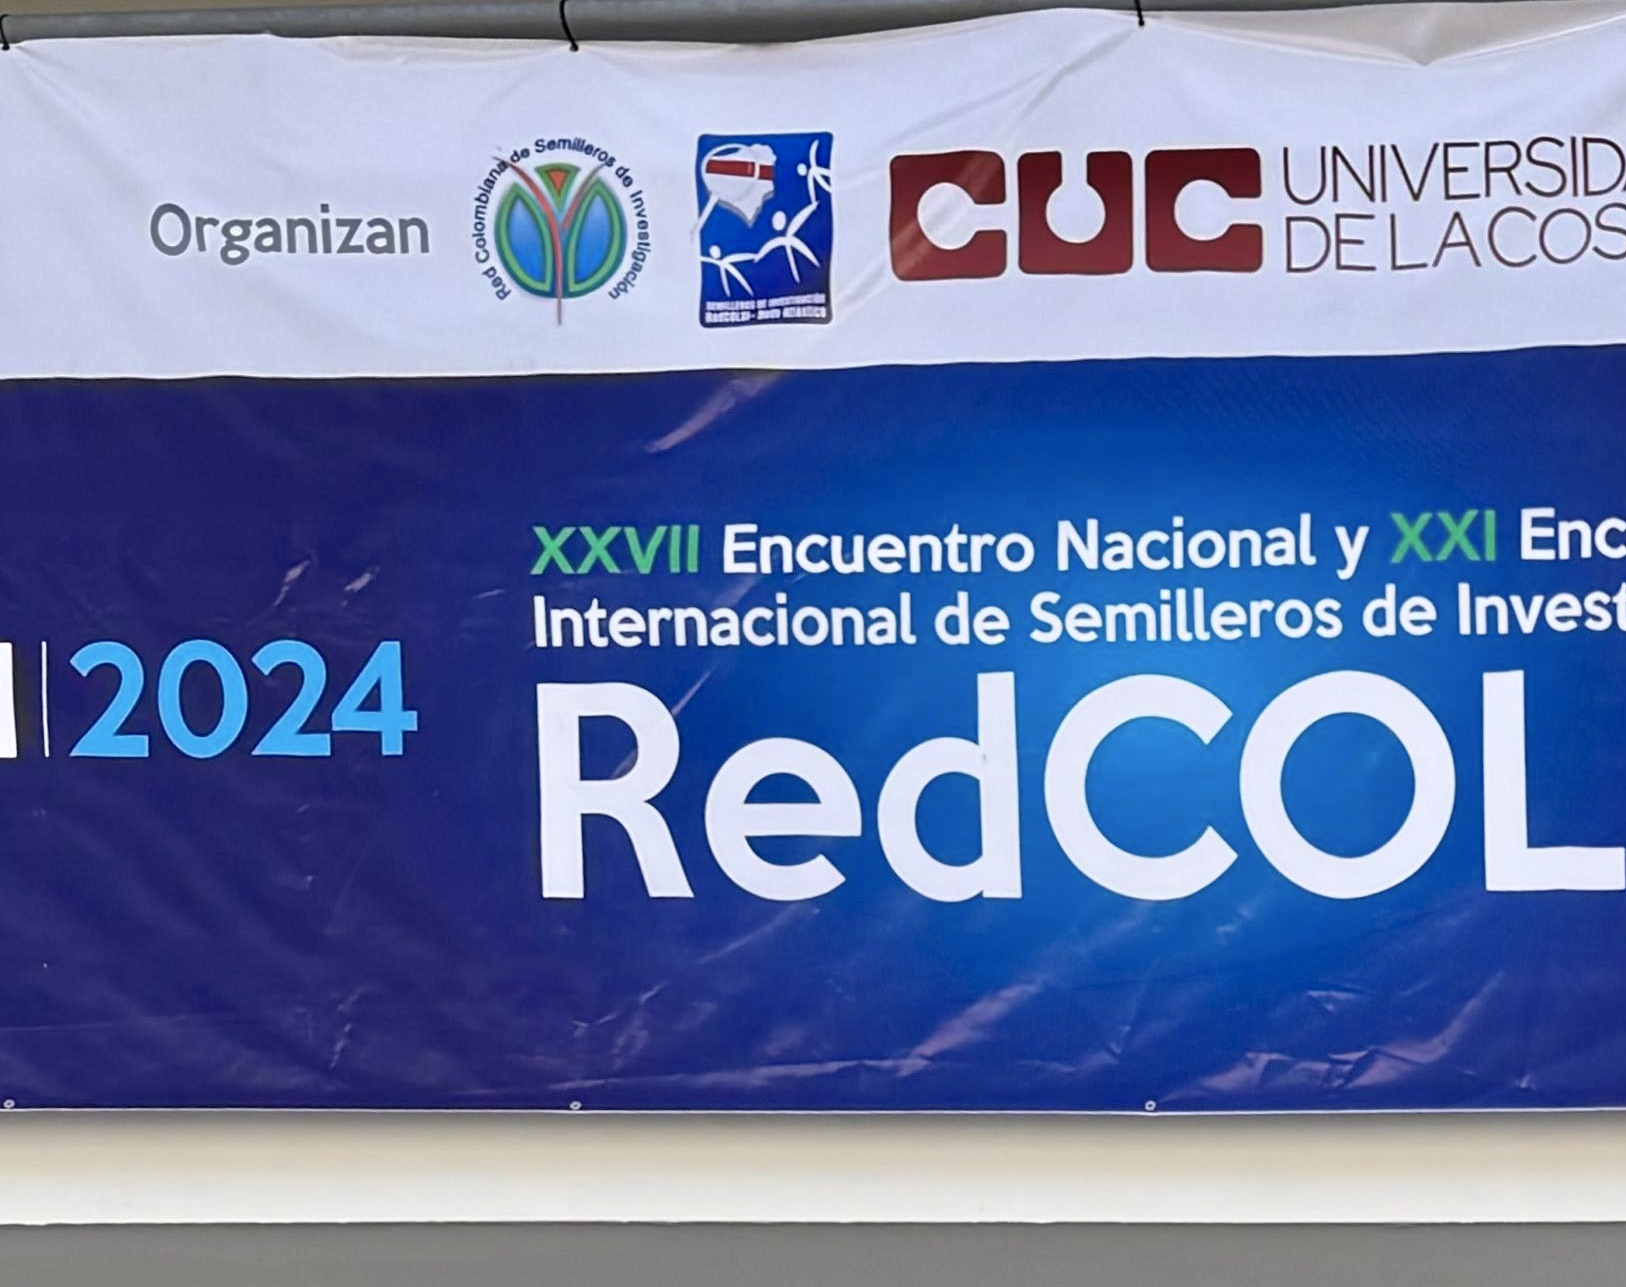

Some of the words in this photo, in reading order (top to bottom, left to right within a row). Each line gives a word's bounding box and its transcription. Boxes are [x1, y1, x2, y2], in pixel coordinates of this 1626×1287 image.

[510, 148, 531, 164] de
[534, 137, 617, 168] Semilleros
[615, 166, 634, 187] de
[150, 203, 430, 265] Organizan
[472, 160, 510, 264] Colombiana
[607, 190, 652, 300] Investigación
[890, 148, 1264, 281] CUC
[482, 266, 512, 301] Red
[530, 525, 699, 576] XXVII
[722, 522, 1035, 575] Encuentro
[1056, 513, 1316, 573] Nacional
[1335, 521, 1371, 580] y
[1389, 510, 1497, 564] XXI
[533, 595, 916, 649] Internacional
[935, 592, 1010, 646] de
[1030, 588, 1343, 644] Semilleros
[1362, 582, 1437, 638] de
[68, 640, 419, 760] 2024
